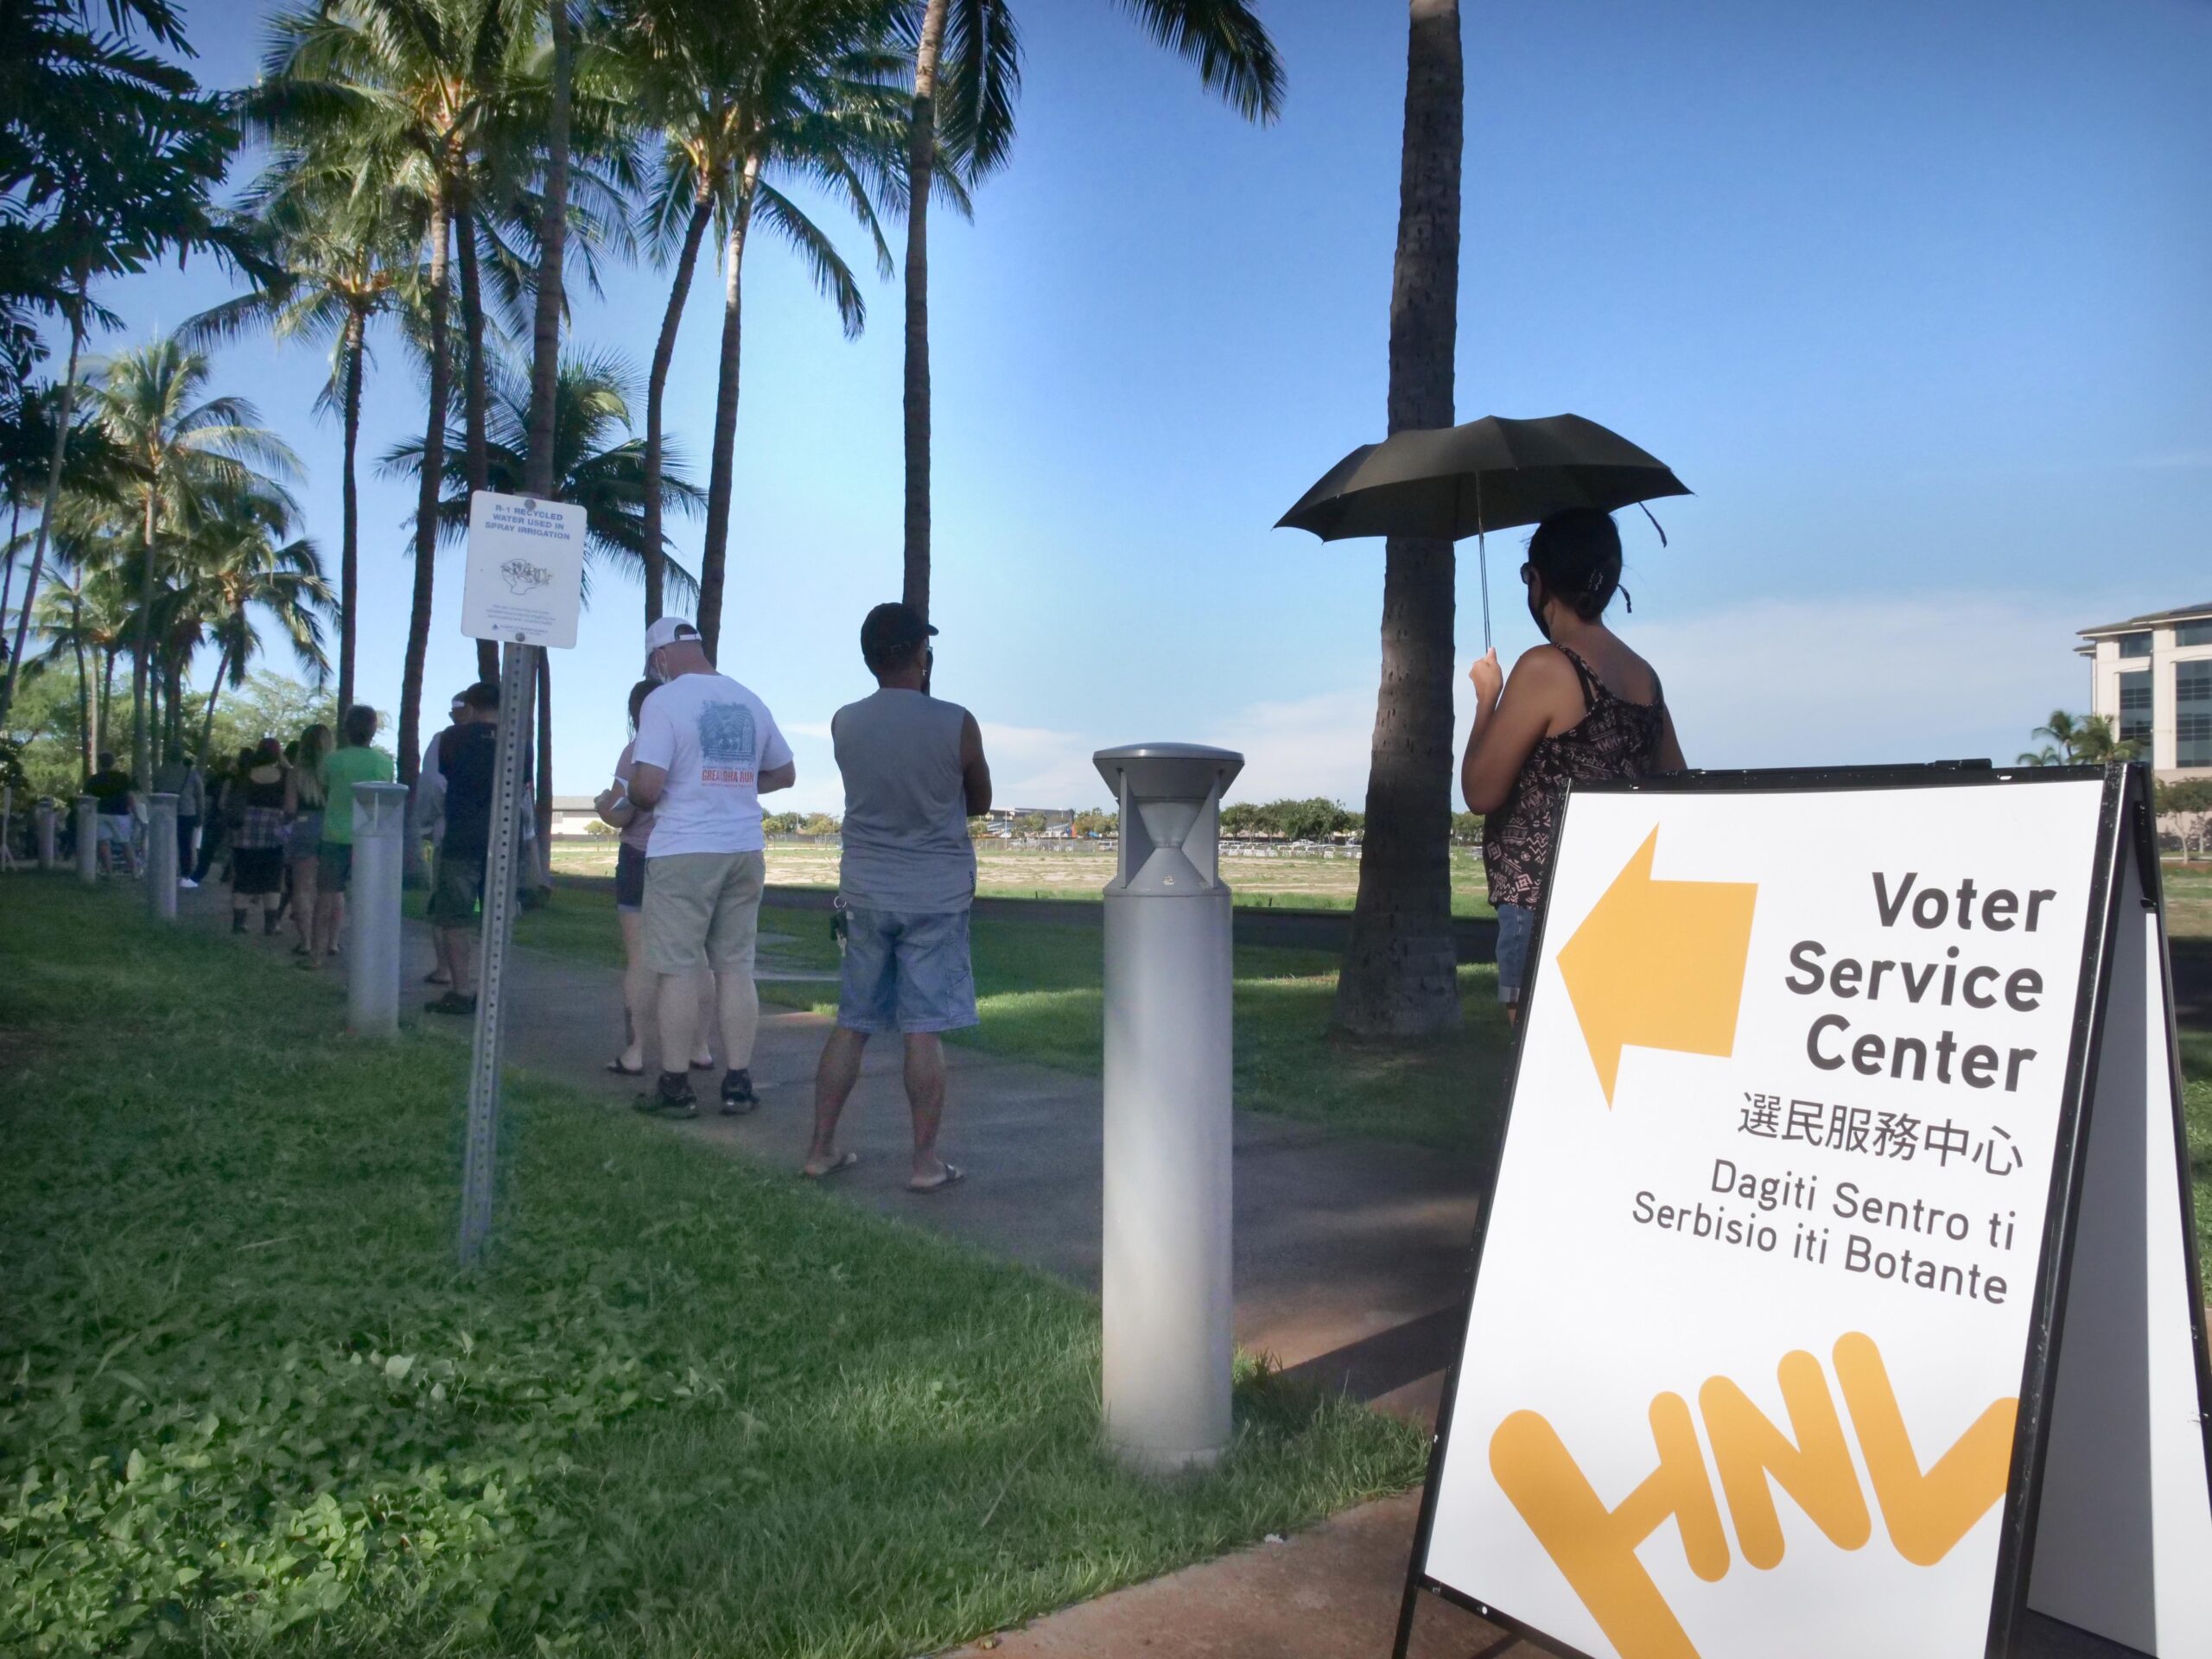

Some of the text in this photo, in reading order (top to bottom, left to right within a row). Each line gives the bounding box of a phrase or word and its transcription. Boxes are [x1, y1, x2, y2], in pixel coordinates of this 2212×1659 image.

[485, 521, 570, 540] SPRAY IRRIGATION
[493, 513, 524, 524] WATER
[527, 518, 552, 528] USED
[514, 507, 563, 521] RECYCLED
[1872, 872, 2057, 932] Voter
[1785, 940, 2044, 1013] Service
[1807, 1014, 2037, 1092] Center
[1737, 1091, 2024, 1177] 選民服務中心
[1712, 1159, 2015, 1251] Dagiti Sentro ti
[1631, 1191, 2008, 1305] Serbisio iti Botante
[1489, 1332, 2019, 1659] HNL
